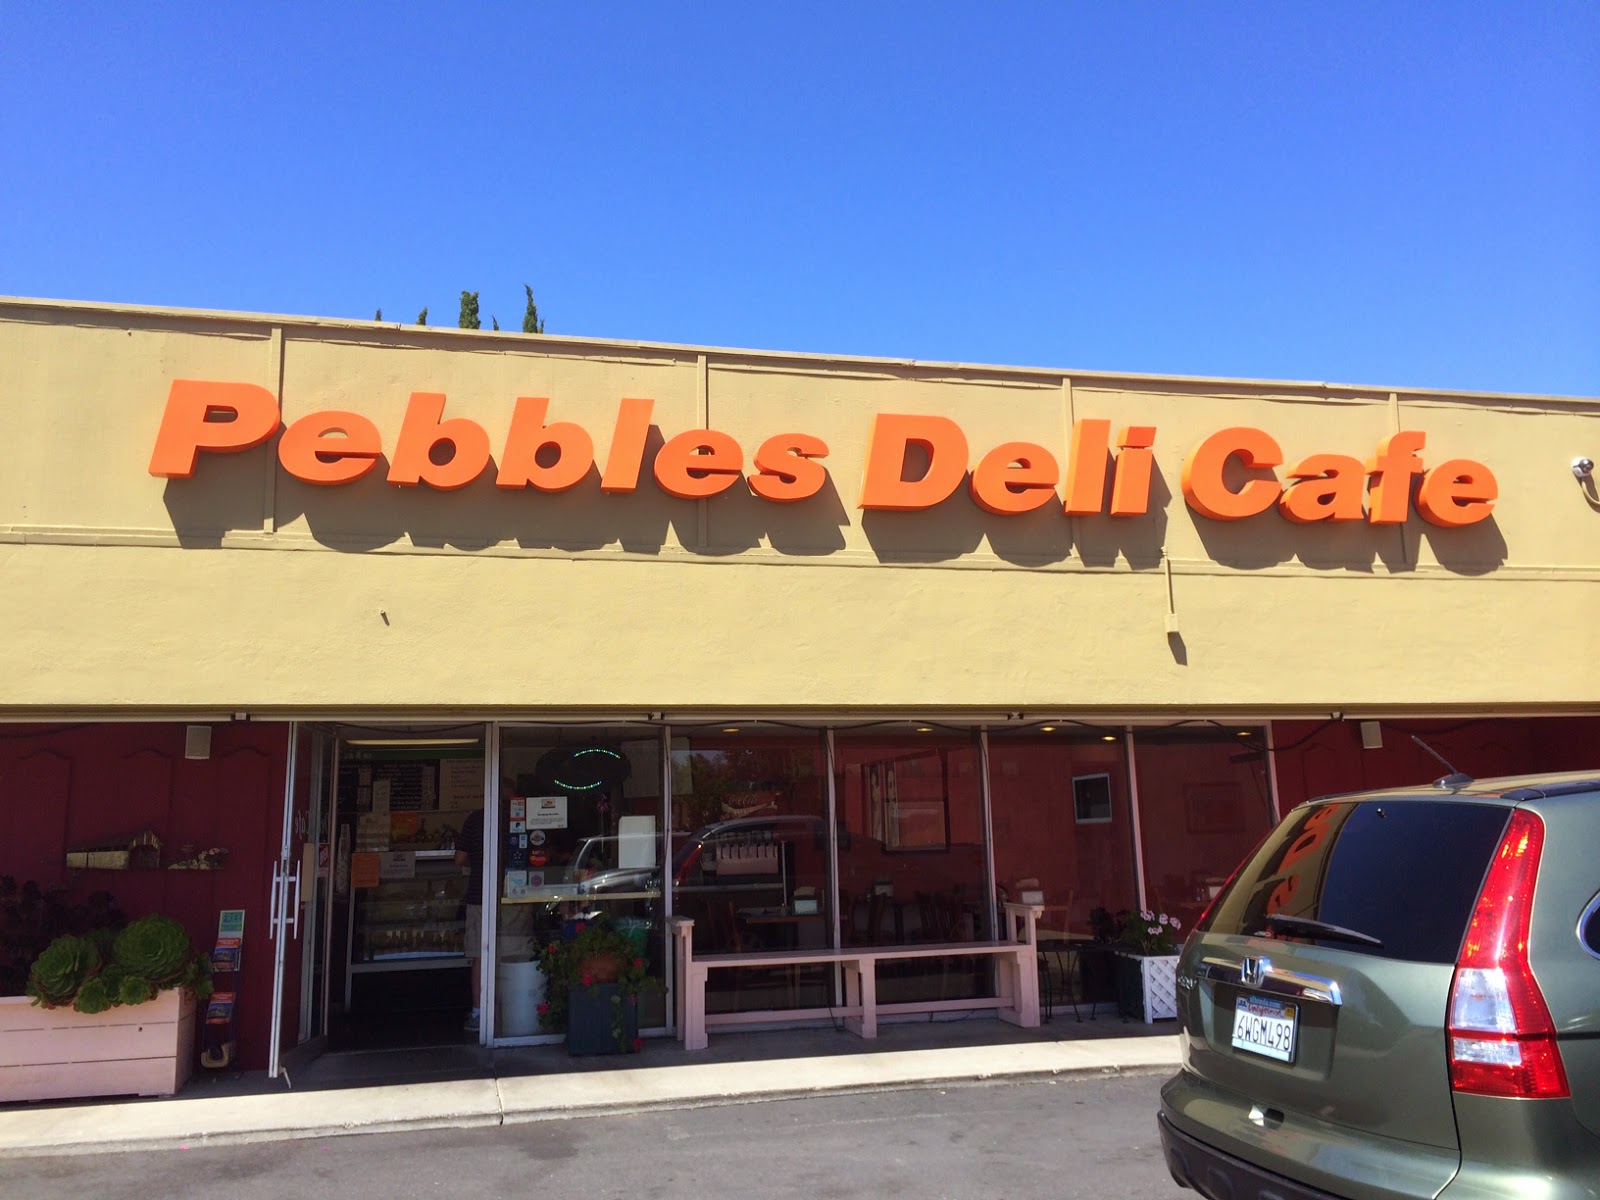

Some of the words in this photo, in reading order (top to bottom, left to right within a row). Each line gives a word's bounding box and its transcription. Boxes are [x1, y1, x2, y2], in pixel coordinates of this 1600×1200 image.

[148, 379, 829, 501] Pebbles
[857, 413, 1157, 518] Deli
[1181, 426, 1499, 528] Cafe
[1237, 1015, 1291, 1051] 6WGM498
